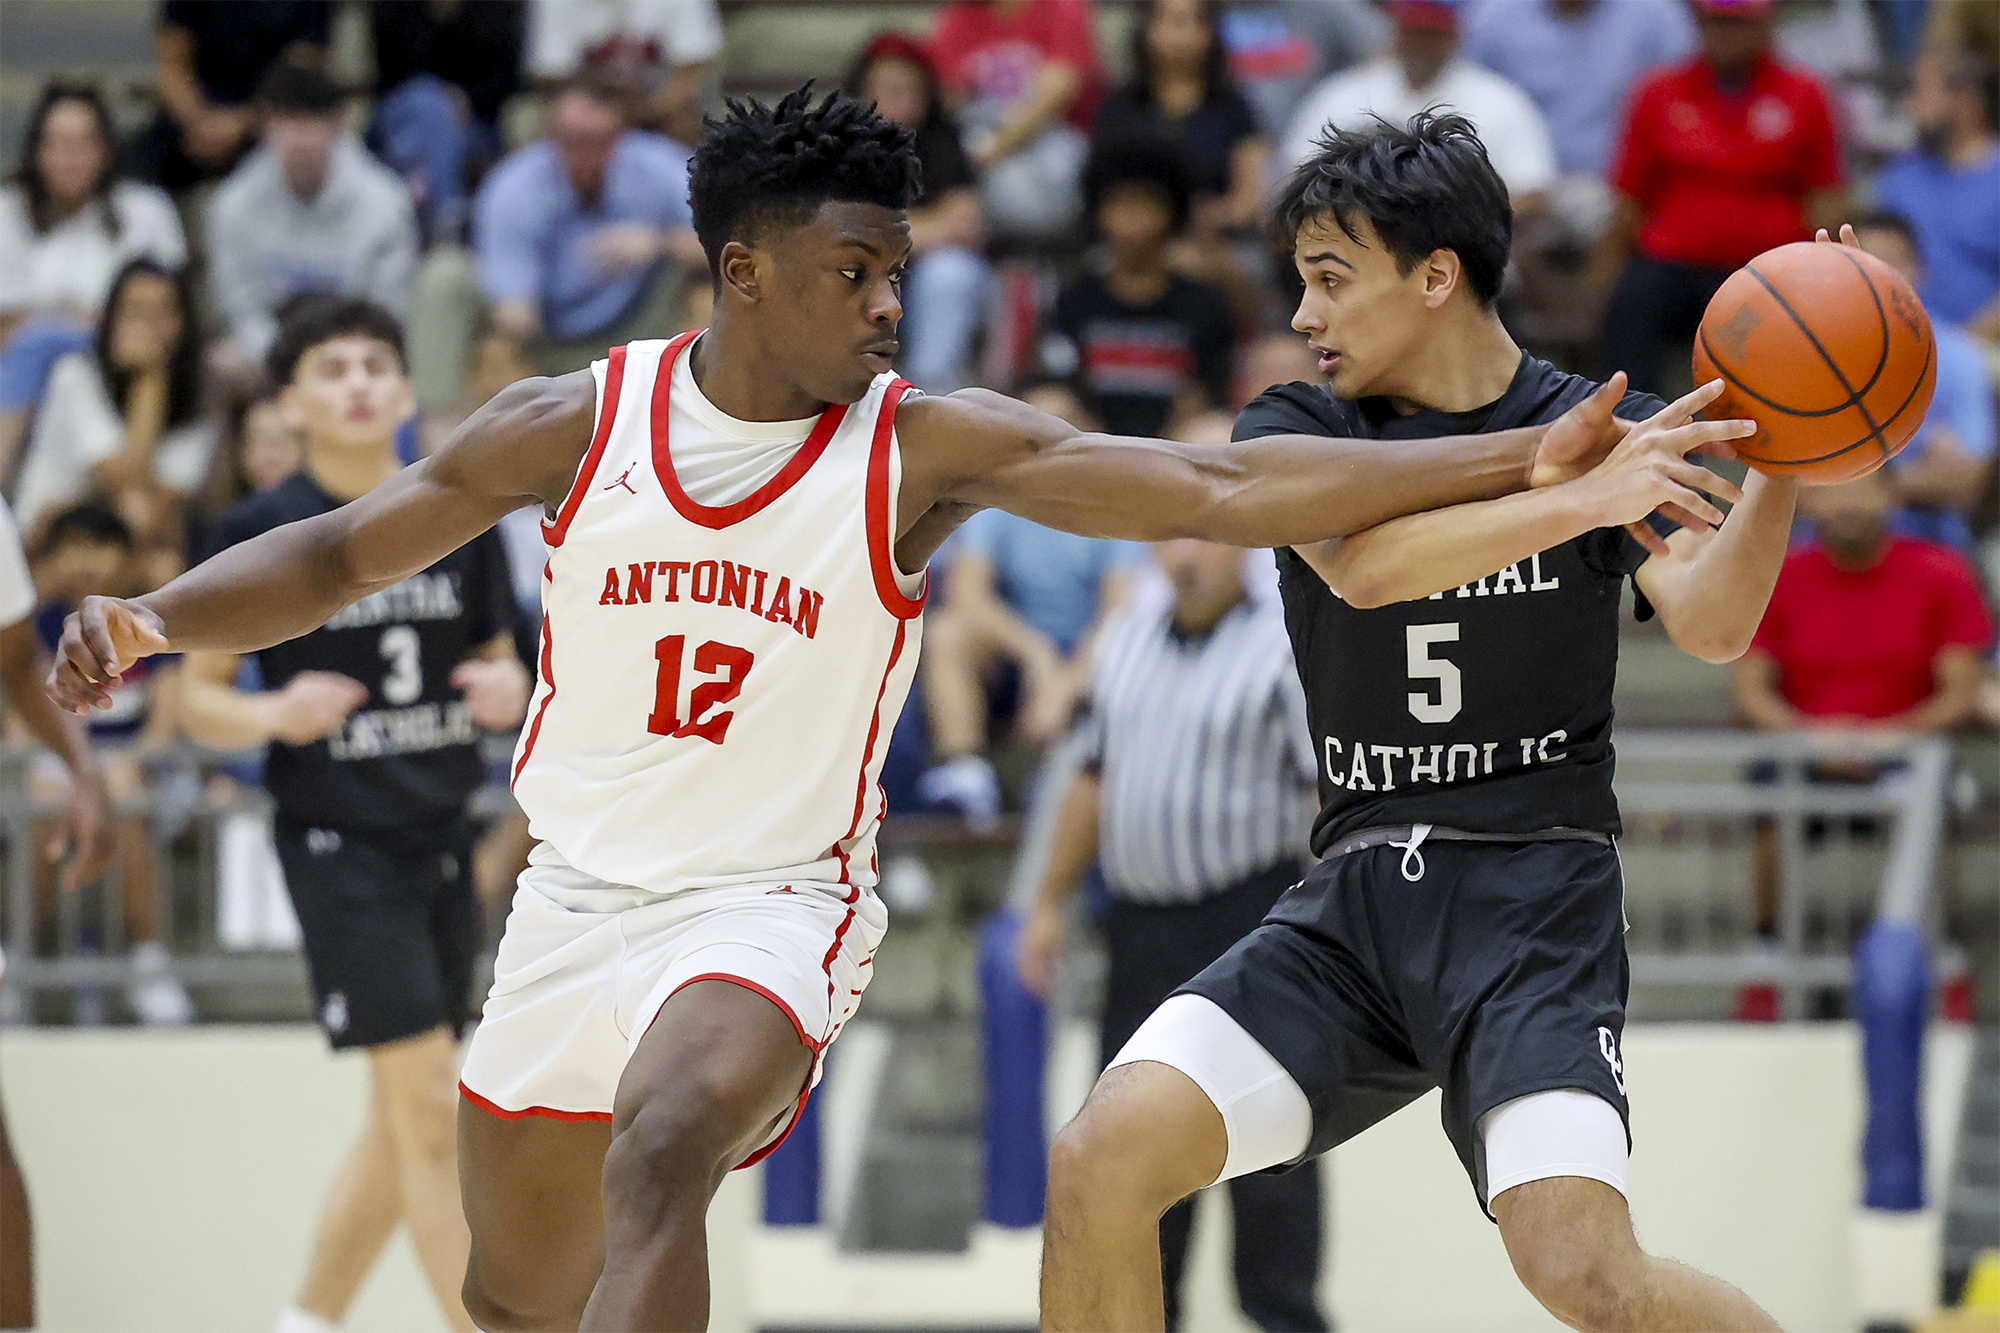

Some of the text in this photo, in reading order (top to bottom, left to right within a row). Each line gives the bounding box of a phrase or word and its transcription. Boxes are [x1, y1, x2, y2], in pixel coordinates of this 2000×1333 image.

[598, 560, 824, 639] ANTONIAN
[379, 624, 423, 704] 3
[647, 634, 754, 745] 12
[1406, 622, 1462, 723] 5
